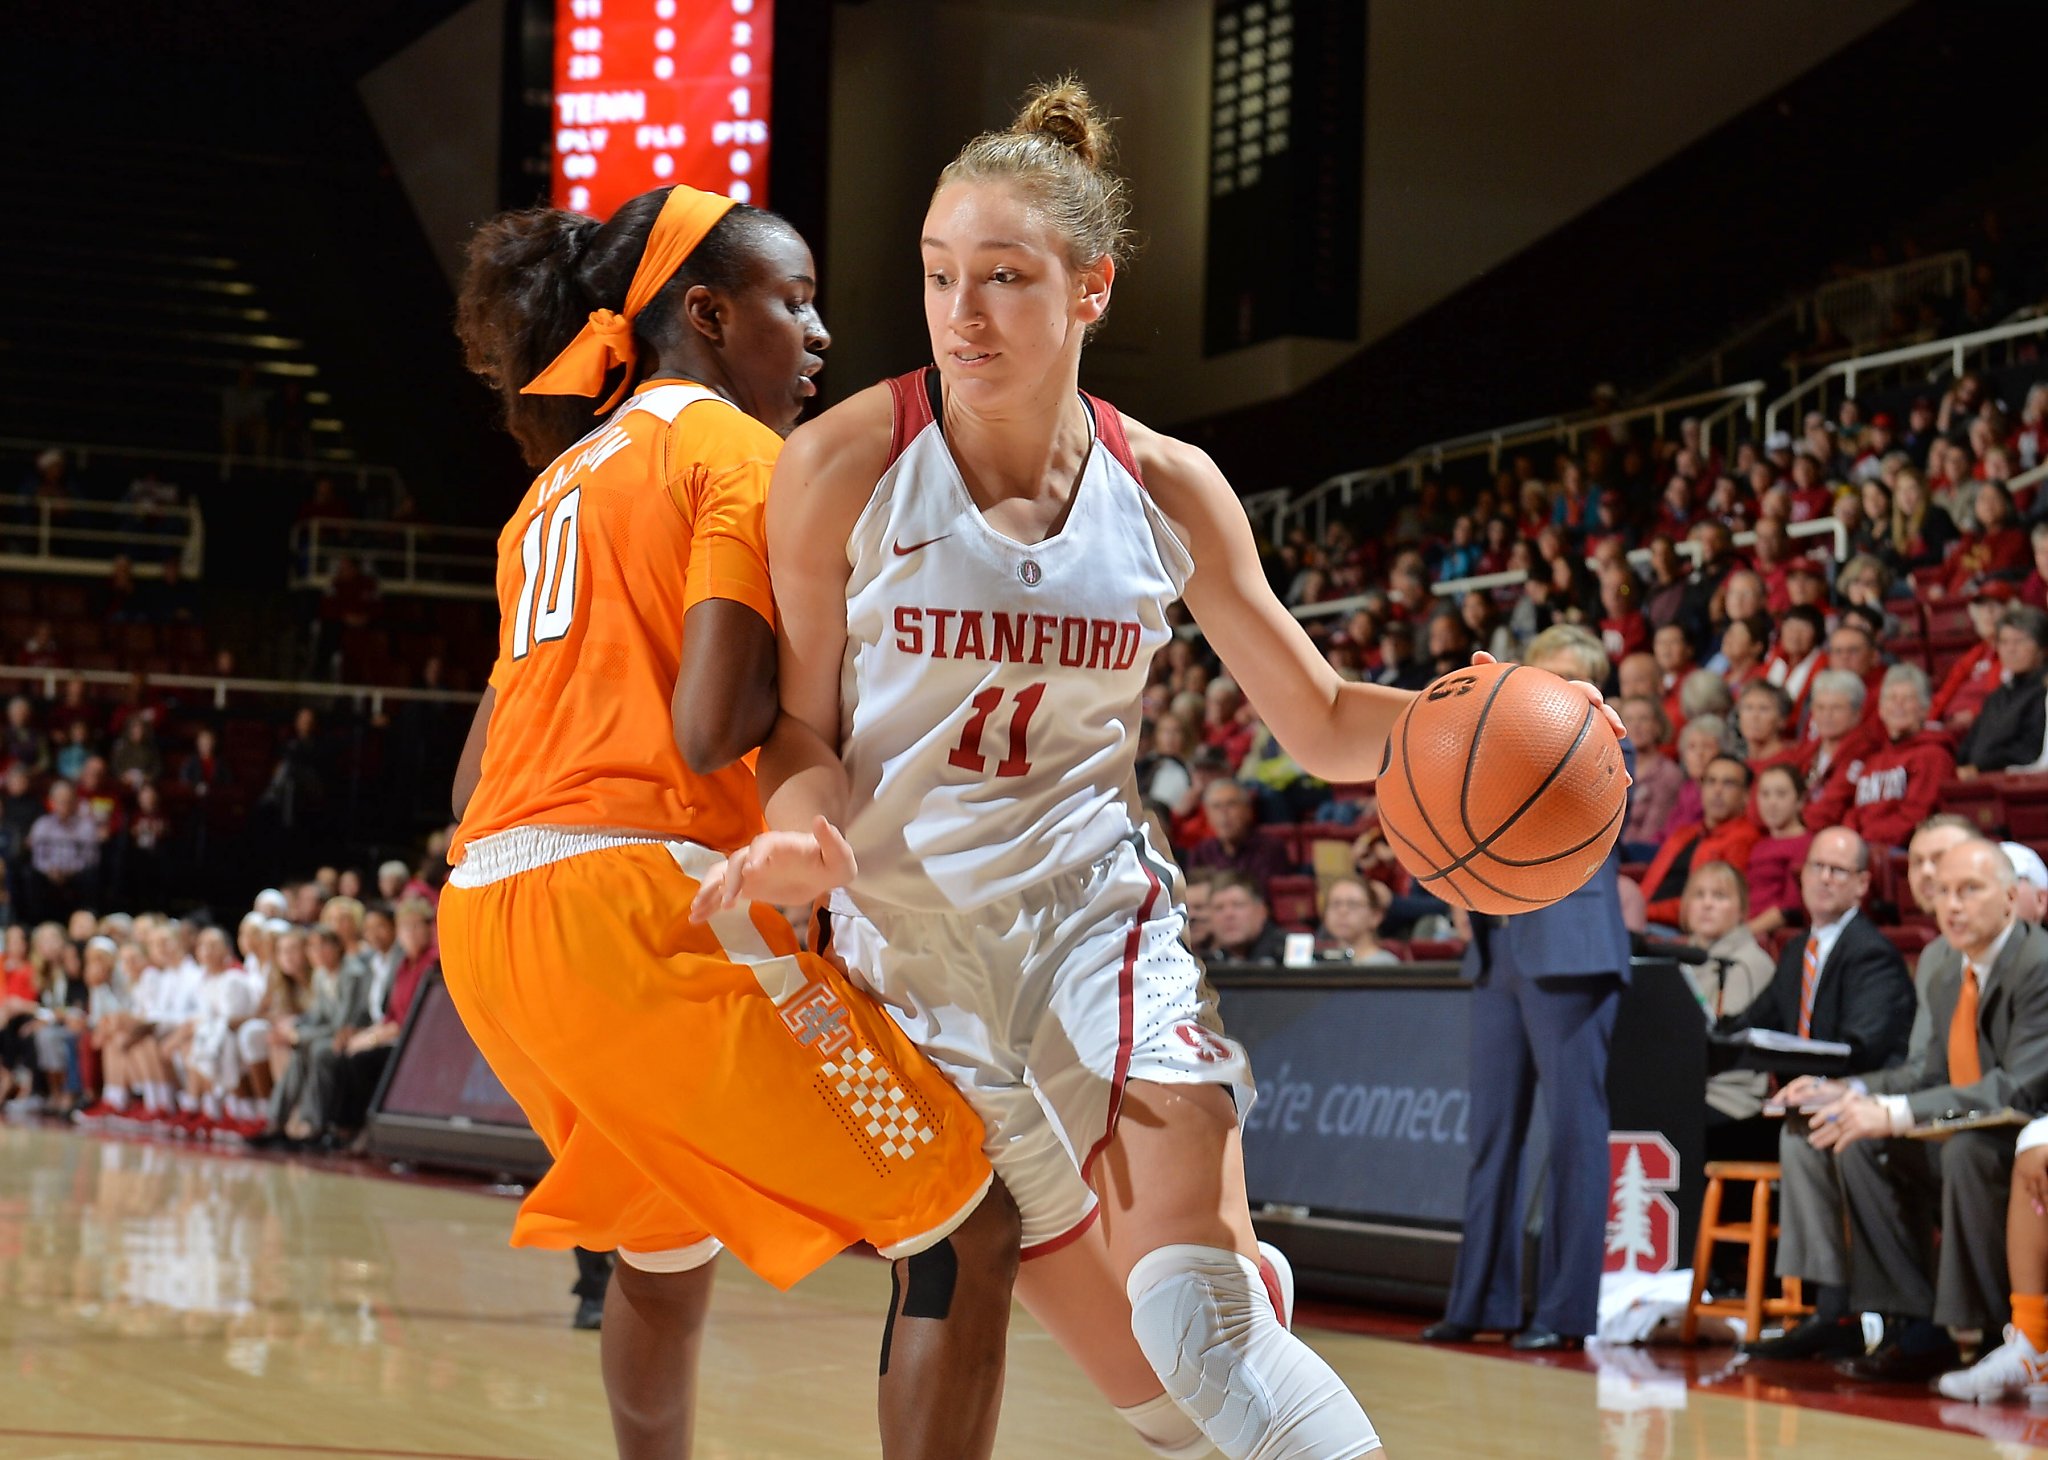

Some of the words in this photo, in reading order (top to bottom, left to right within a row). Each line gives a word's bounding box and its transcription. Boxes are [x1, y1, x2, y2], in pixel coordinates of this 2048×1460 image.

[512, 484, 581, 662] 10
[893, 605, 1142, 670] STANFORD
[948, 682, 1046, 777] 11
[1248, 1062, 1314, 1133] e're
